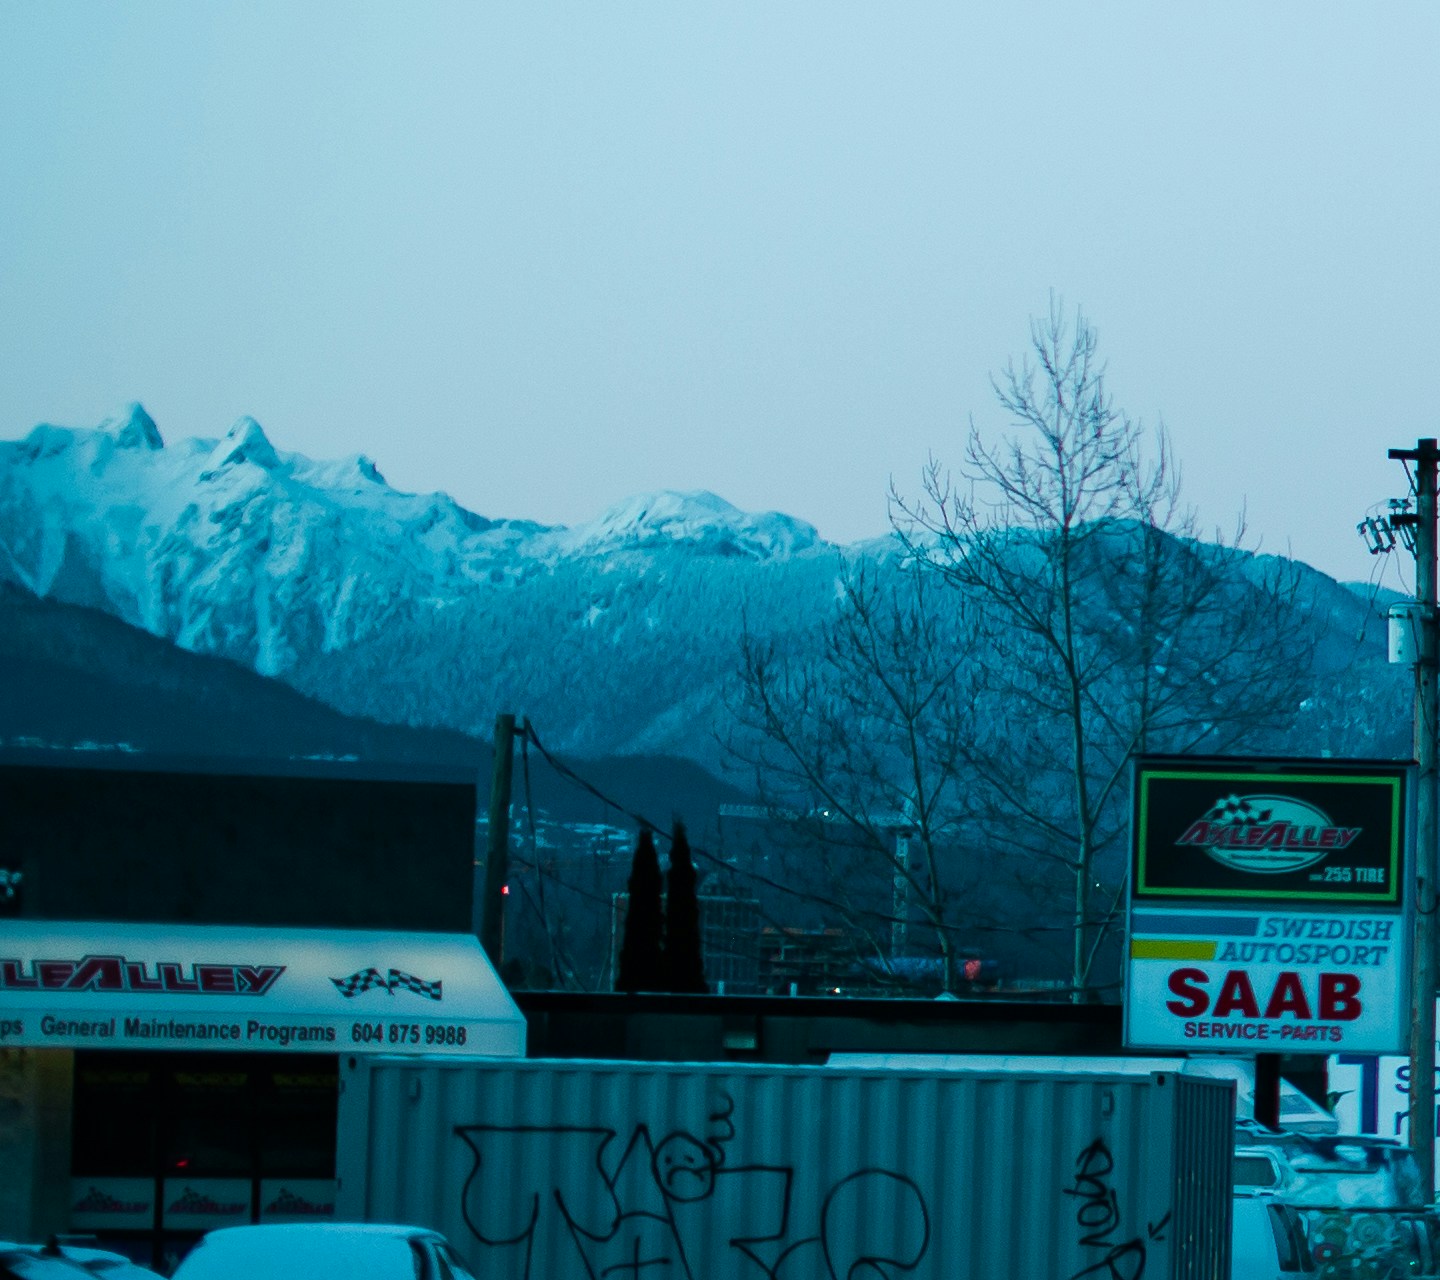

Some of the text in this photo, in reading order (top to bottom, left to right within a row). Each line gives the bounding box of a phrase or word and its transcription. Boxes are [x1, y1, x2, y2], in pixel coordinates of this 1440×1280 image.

[1355, 868, 1385, 883] TIRE
[1263, 917, 1394, 941] SWEDISH
[1218, 942, 1389, 966] AUTOSPORT
[1166, 967, 1363, 1021] SAAB
[40, 1015, 116, 1038] General
[123, 1017, 241, 1040] Maintenance
[246, 1020, 336, 1046] Programs
[351, 1023, 383, 1042] 604
[388, 1024, 420, 1043] 875
[424, 1025, 467, 1046] 9988
[1184, 1021, 1343, 1042] SERVICE-PARTS
